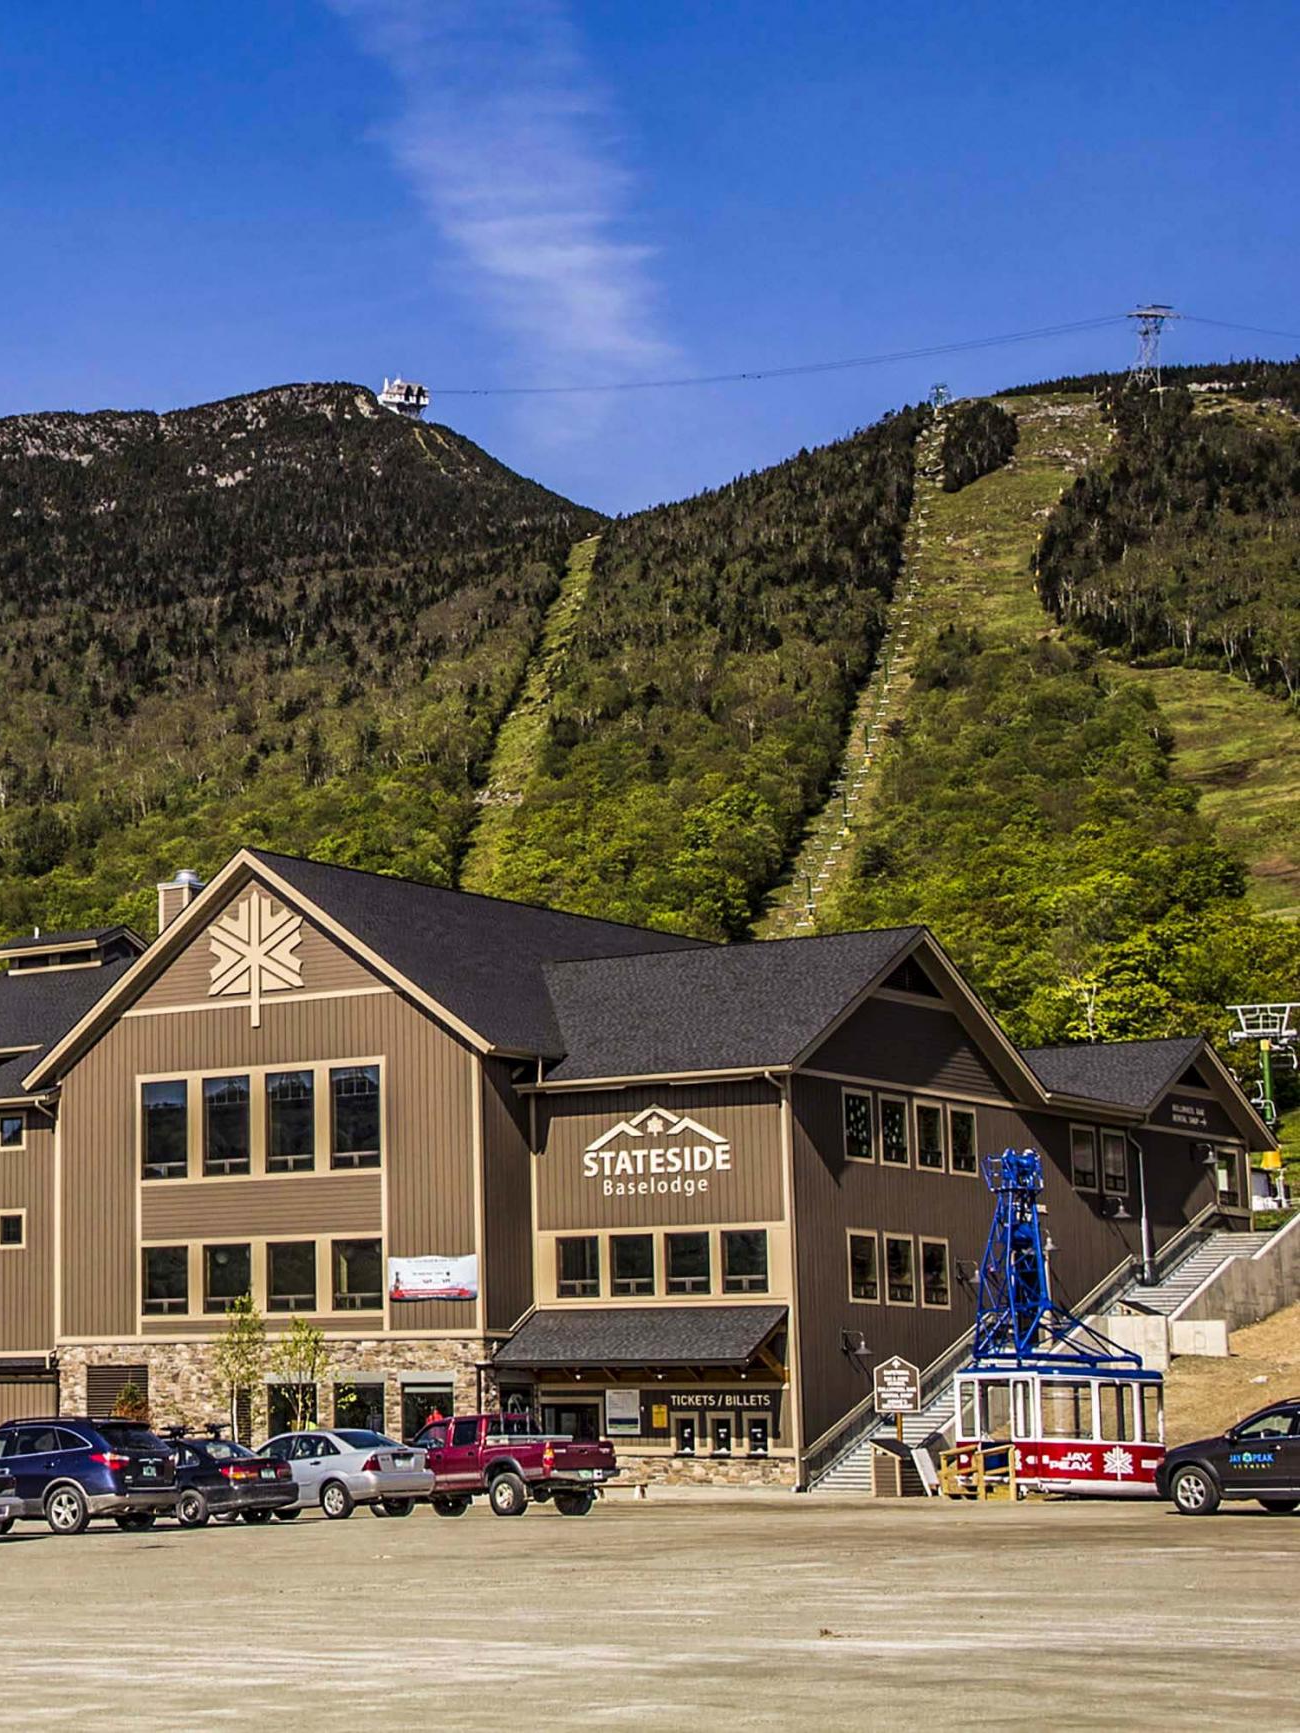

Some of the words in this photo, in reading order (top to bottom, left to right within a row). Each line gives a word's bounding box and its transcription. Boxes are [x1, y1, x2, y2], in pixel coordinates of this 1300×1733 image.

[583, 1144, 731, 1177] STATESIDE
[604, 1176, 708, 1196] Baselodge
[671, 1395, 716, 1406] TICKETS
[717, 1394, 723, 1407] /
[725, 1394, 771, 1406] BILLETS
[1061, 1452, 1092, 1462] JAY
[1229, 1454, 1241, 1463] JAY
[1253, 1453, 1275, 1462] PEAK
[1050, 1460, 1093, 1471] PEAK
